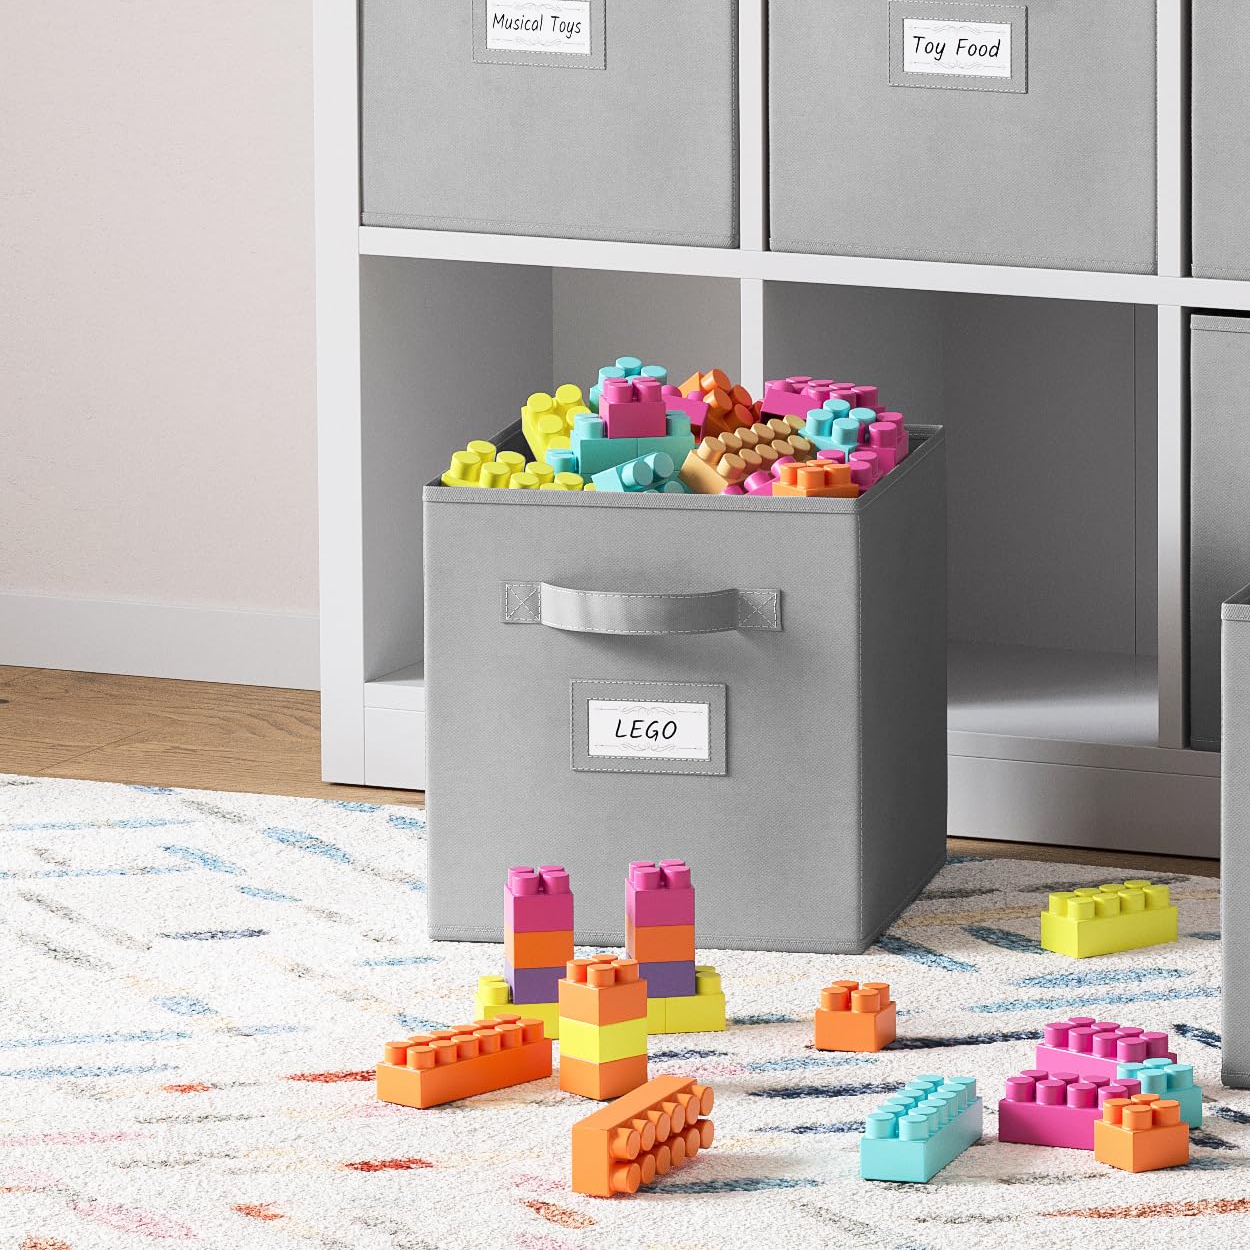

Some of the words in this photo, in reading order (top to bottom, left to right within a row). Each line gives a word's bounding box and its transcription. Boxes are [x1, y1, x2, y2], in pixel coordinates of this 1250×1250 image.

[492, 12, 544, 32] Musical
[550, 15, 582, 40] Toys
[912, 35, 947, 62] Toy
[955, 38, 1002, 58] Food
[615, 718, 678, 742] LEGO
